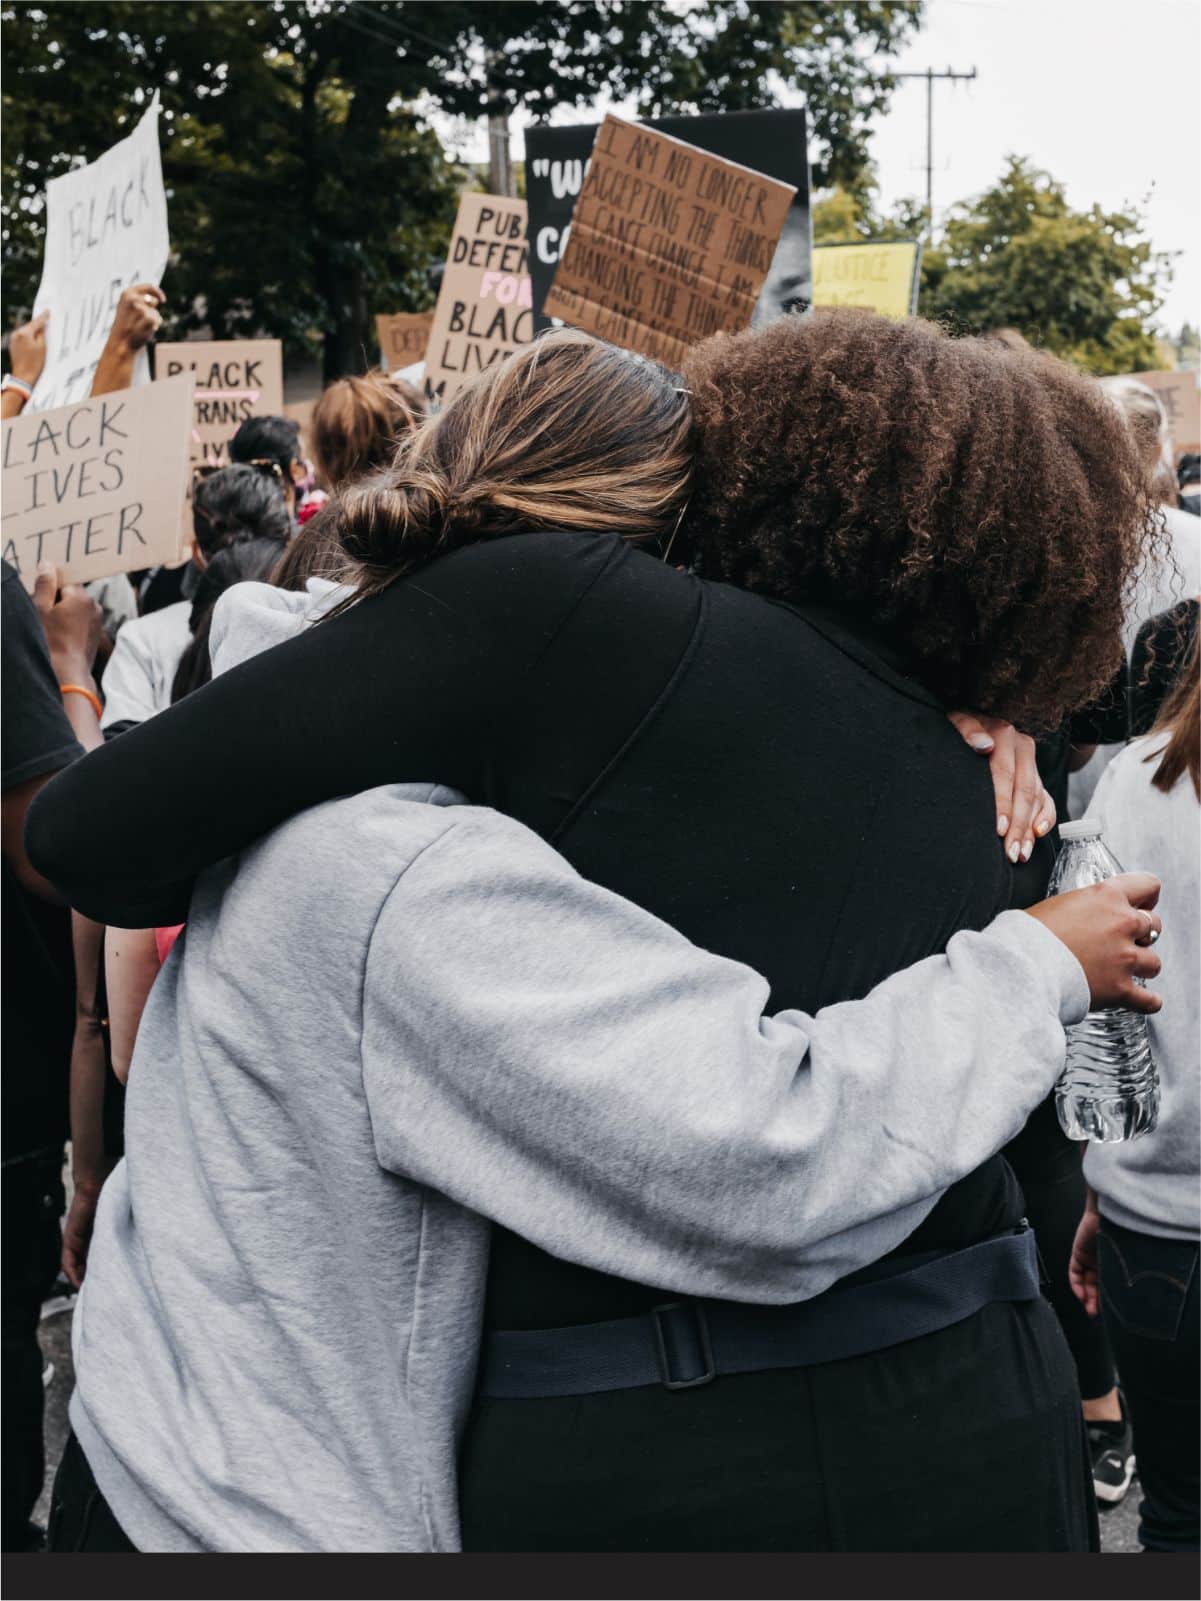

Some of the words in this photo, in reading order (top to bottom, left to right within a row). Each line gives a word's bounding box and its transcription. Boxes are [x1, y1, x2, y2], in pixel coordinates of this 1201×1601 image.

[67, 157, 151, 266] BLACK
[583, 161, 683, 235] ACCEPTING
[687, 204, 718, 250] THE
[598, 119, 625, 158] I
[625, 134, 660, 174] AM
[663, 149, 691, 189] NO
[696, 161, 769, 225] LONGER
[563, 240, 645, 307] CHANGING
[193, 398, 254, 425] RANS
